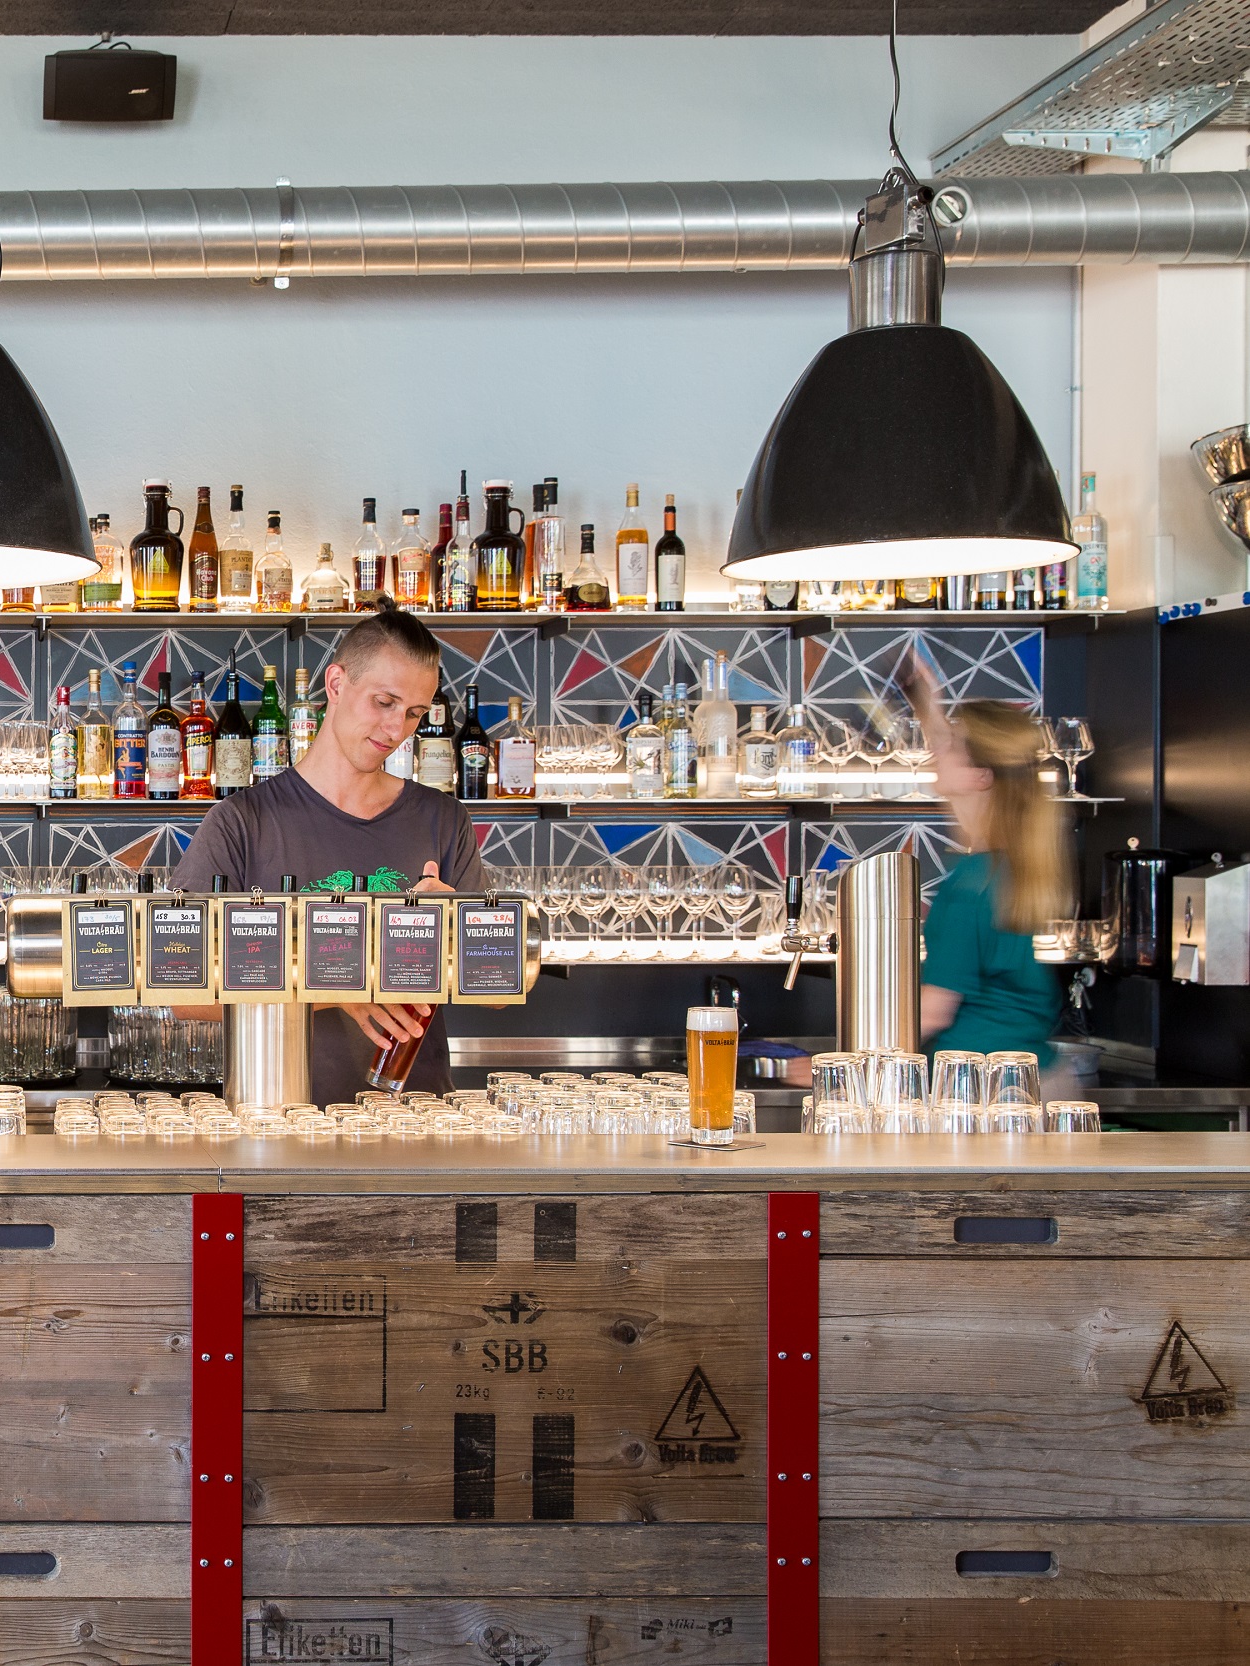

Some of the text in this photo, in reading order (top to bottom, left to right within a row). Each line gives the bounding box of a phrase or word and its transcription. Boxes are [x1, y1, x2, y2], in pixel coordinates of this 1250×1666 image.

[196, 568, 217, 576] Havana
[200, 574, 214, 582] Club
[114, 738, 146, 748] BITTER
[150, 751, 180, 760] BARDOUIN
[78, 924, 125, 936] VOLTA BRÄU
[154, 923, 200, 934] VOLTA BRÄU
[231, 926, 277, 936] VOLTA BRÄU
[388, 928, 435, 938] VOLTA BRÄU
[465, 926, 515, 937] VOLTA BRÄU
[163, 946, 191, 954] WHEAT
[247, 946, 261, 954] IPA
[319, 942, 352, 953] PALE ALE
[723, 1038, 735, 1046] BRÄU
[482, 1339, 548, 1373] SBB
[455, 1384, 490, 1401] 23kg
[261, 1624, 381, 1656] Etiketten
